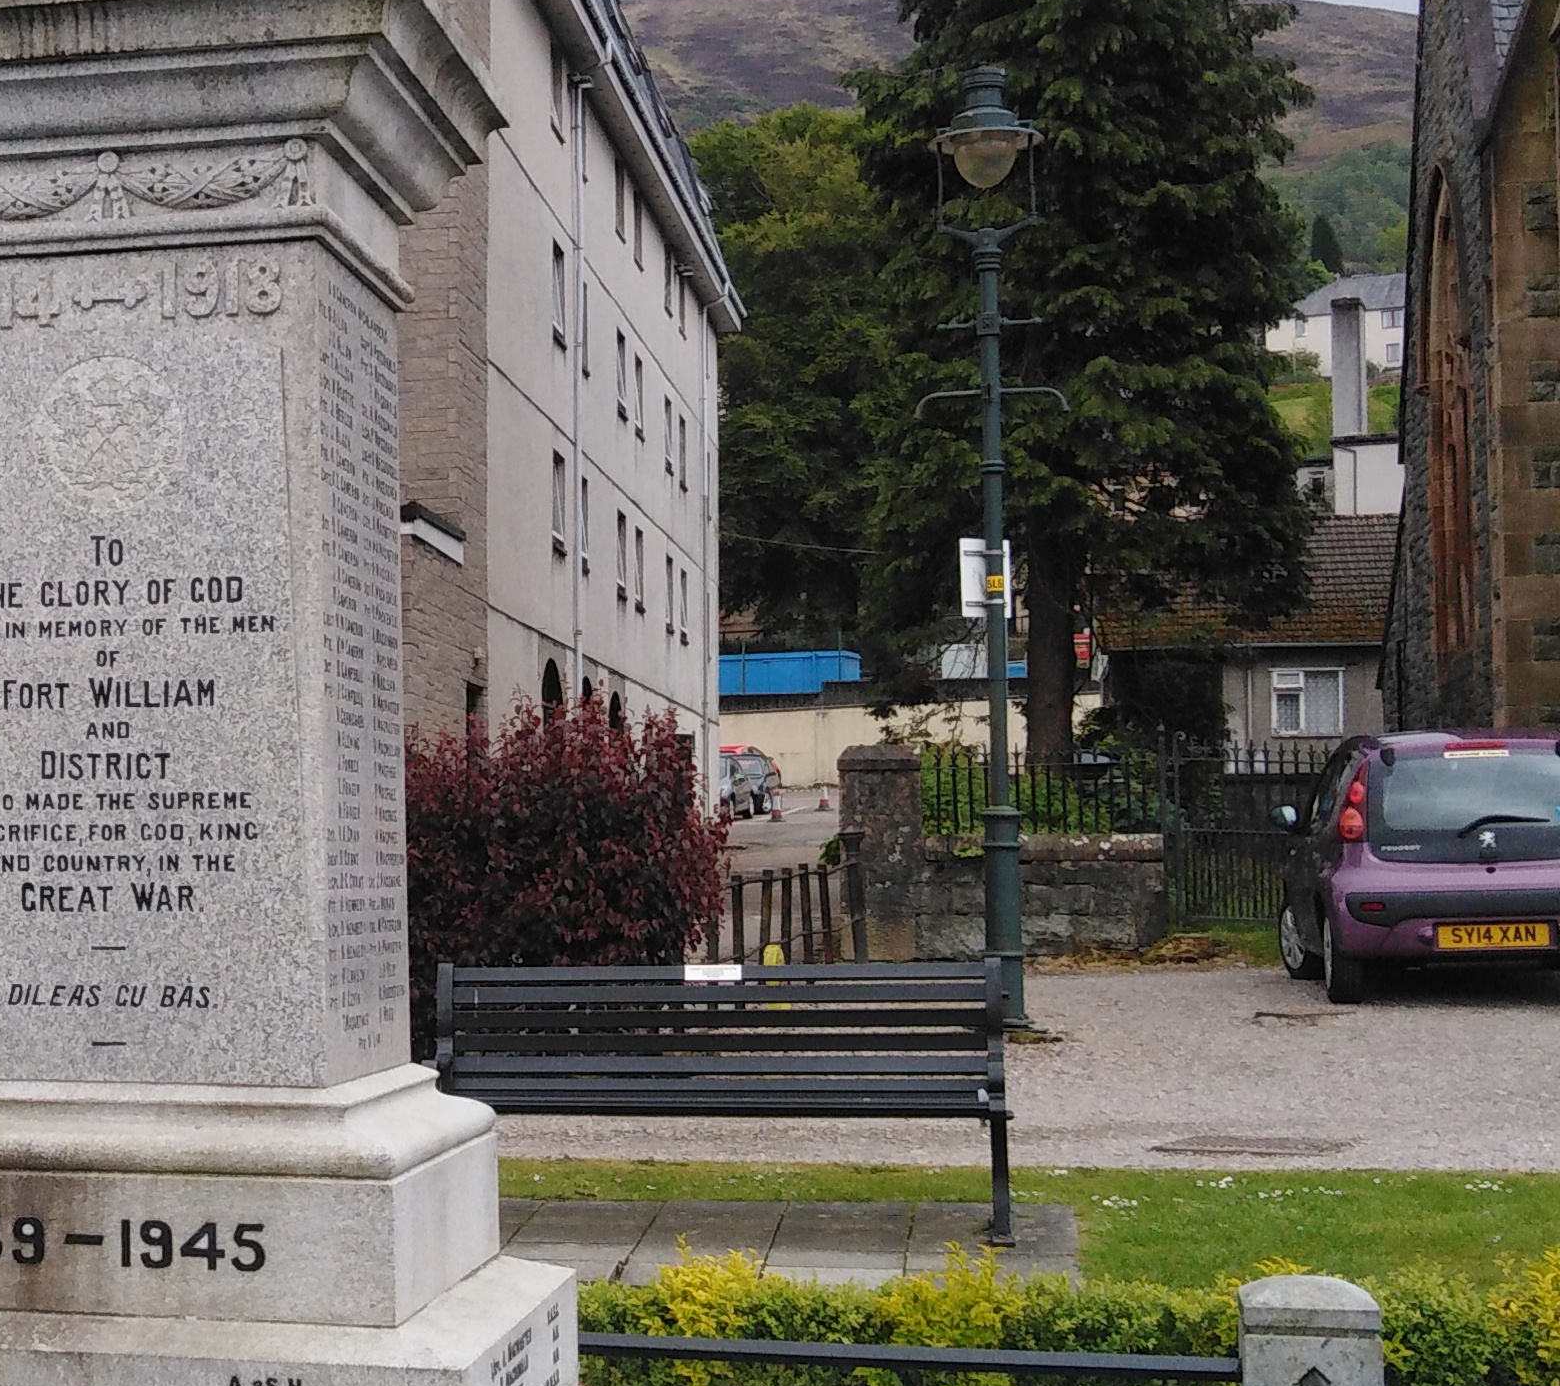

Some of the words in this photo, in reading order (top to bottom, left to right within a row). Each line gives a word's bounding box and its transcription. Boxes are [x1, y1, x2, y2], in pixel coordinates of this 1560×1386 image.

[161, 252, 282, 319] 1918
[91, 536, 124, 566] TO
[40, 579, 130, 608] GLORY
[147, 578, 176, 605] OF
[190, 576, 243, 603] GOD
[5, 621, 26, 638] IN
[38, 619, 128, 638] MEMORY
[142, 618, 166, 635] OF
[180, 616, 220, 635] THE
[232, 615, 275, 633] MEN
[96, 650, 119, 667] OF
[3, 680, 69, 709] FORT
[88, 677, 215, 708] WILLIAM
[86, 721, 130, 739] AND
[41, 751, 171, 780] DISTRICT
[26, 793, 83, 810] MADE
[96, 793, 135, 810] THE
[148, 792, 252, 810] SUPREME
[89, 824, 126, 840] FOR
[200, 821, 258, 840] KING
[43, 855, 151, 876] COUNTRY,
[159, 855, 179, 871] IN
[192, 854, 236, 872] THE
[21, 882, 113, 912] GREAT
[1451, 926, 1493, 944] SY14
[1499, 925, 1536, 943] XAN
[8, 983, 101, 1007] DILEAS
